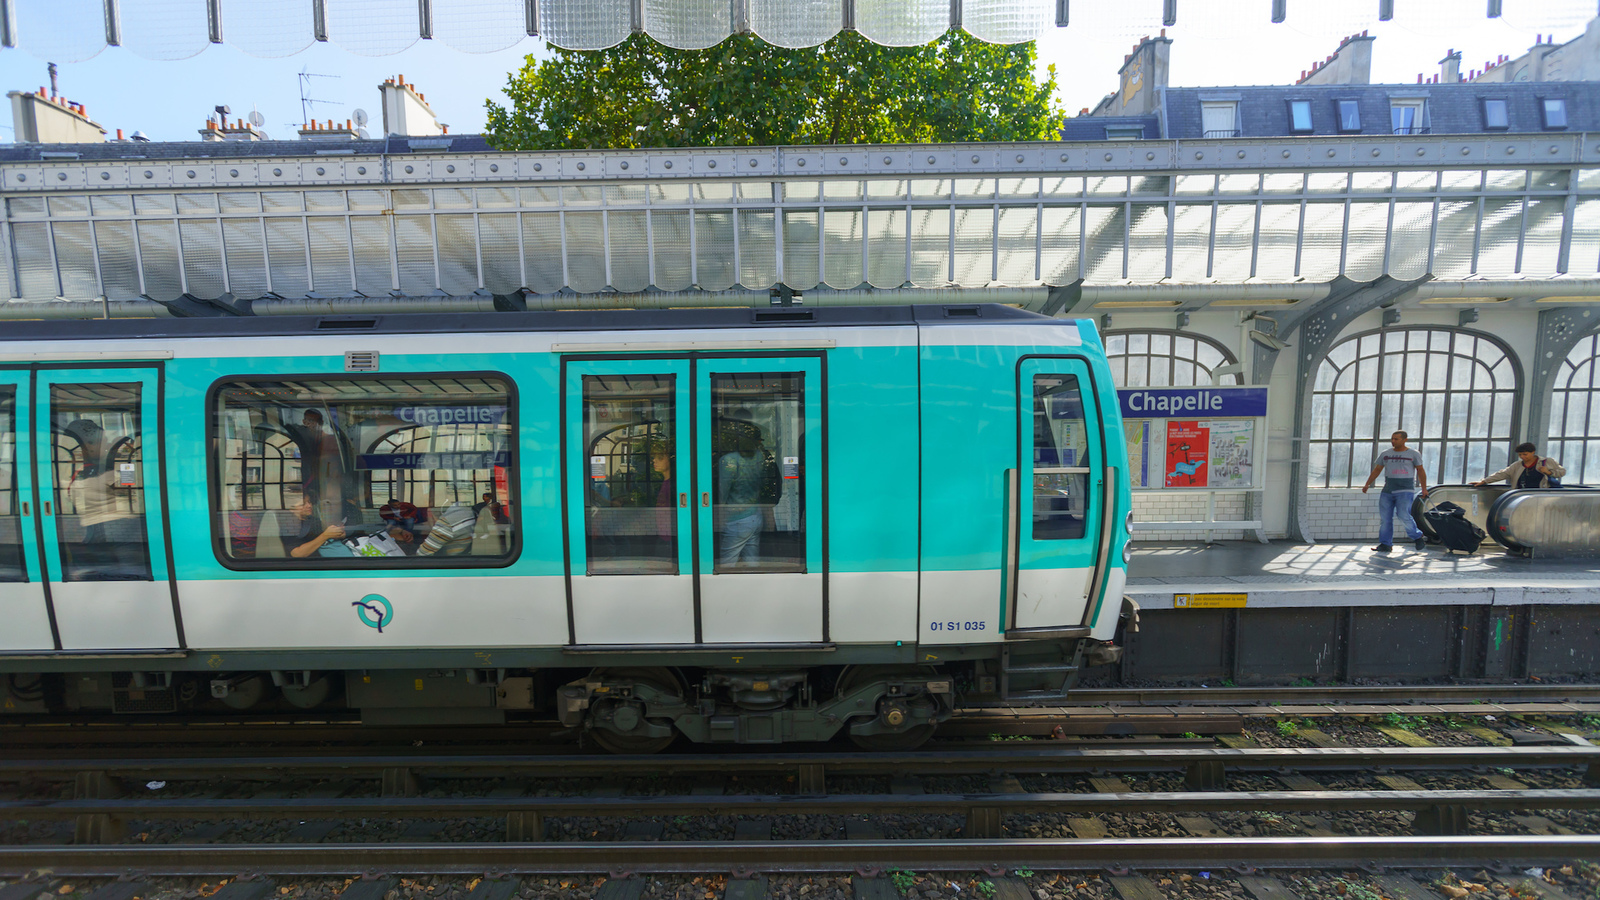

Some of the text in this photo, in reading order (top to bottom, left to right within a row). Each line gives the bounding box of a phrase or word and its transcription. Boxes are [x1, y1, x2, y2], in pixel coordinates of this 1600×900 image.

[1128, 391, 1223, 415] Chapelle
[399, 406, 491, 425] Chapelle
[930, 621, 986, 631] 01 S1 035
